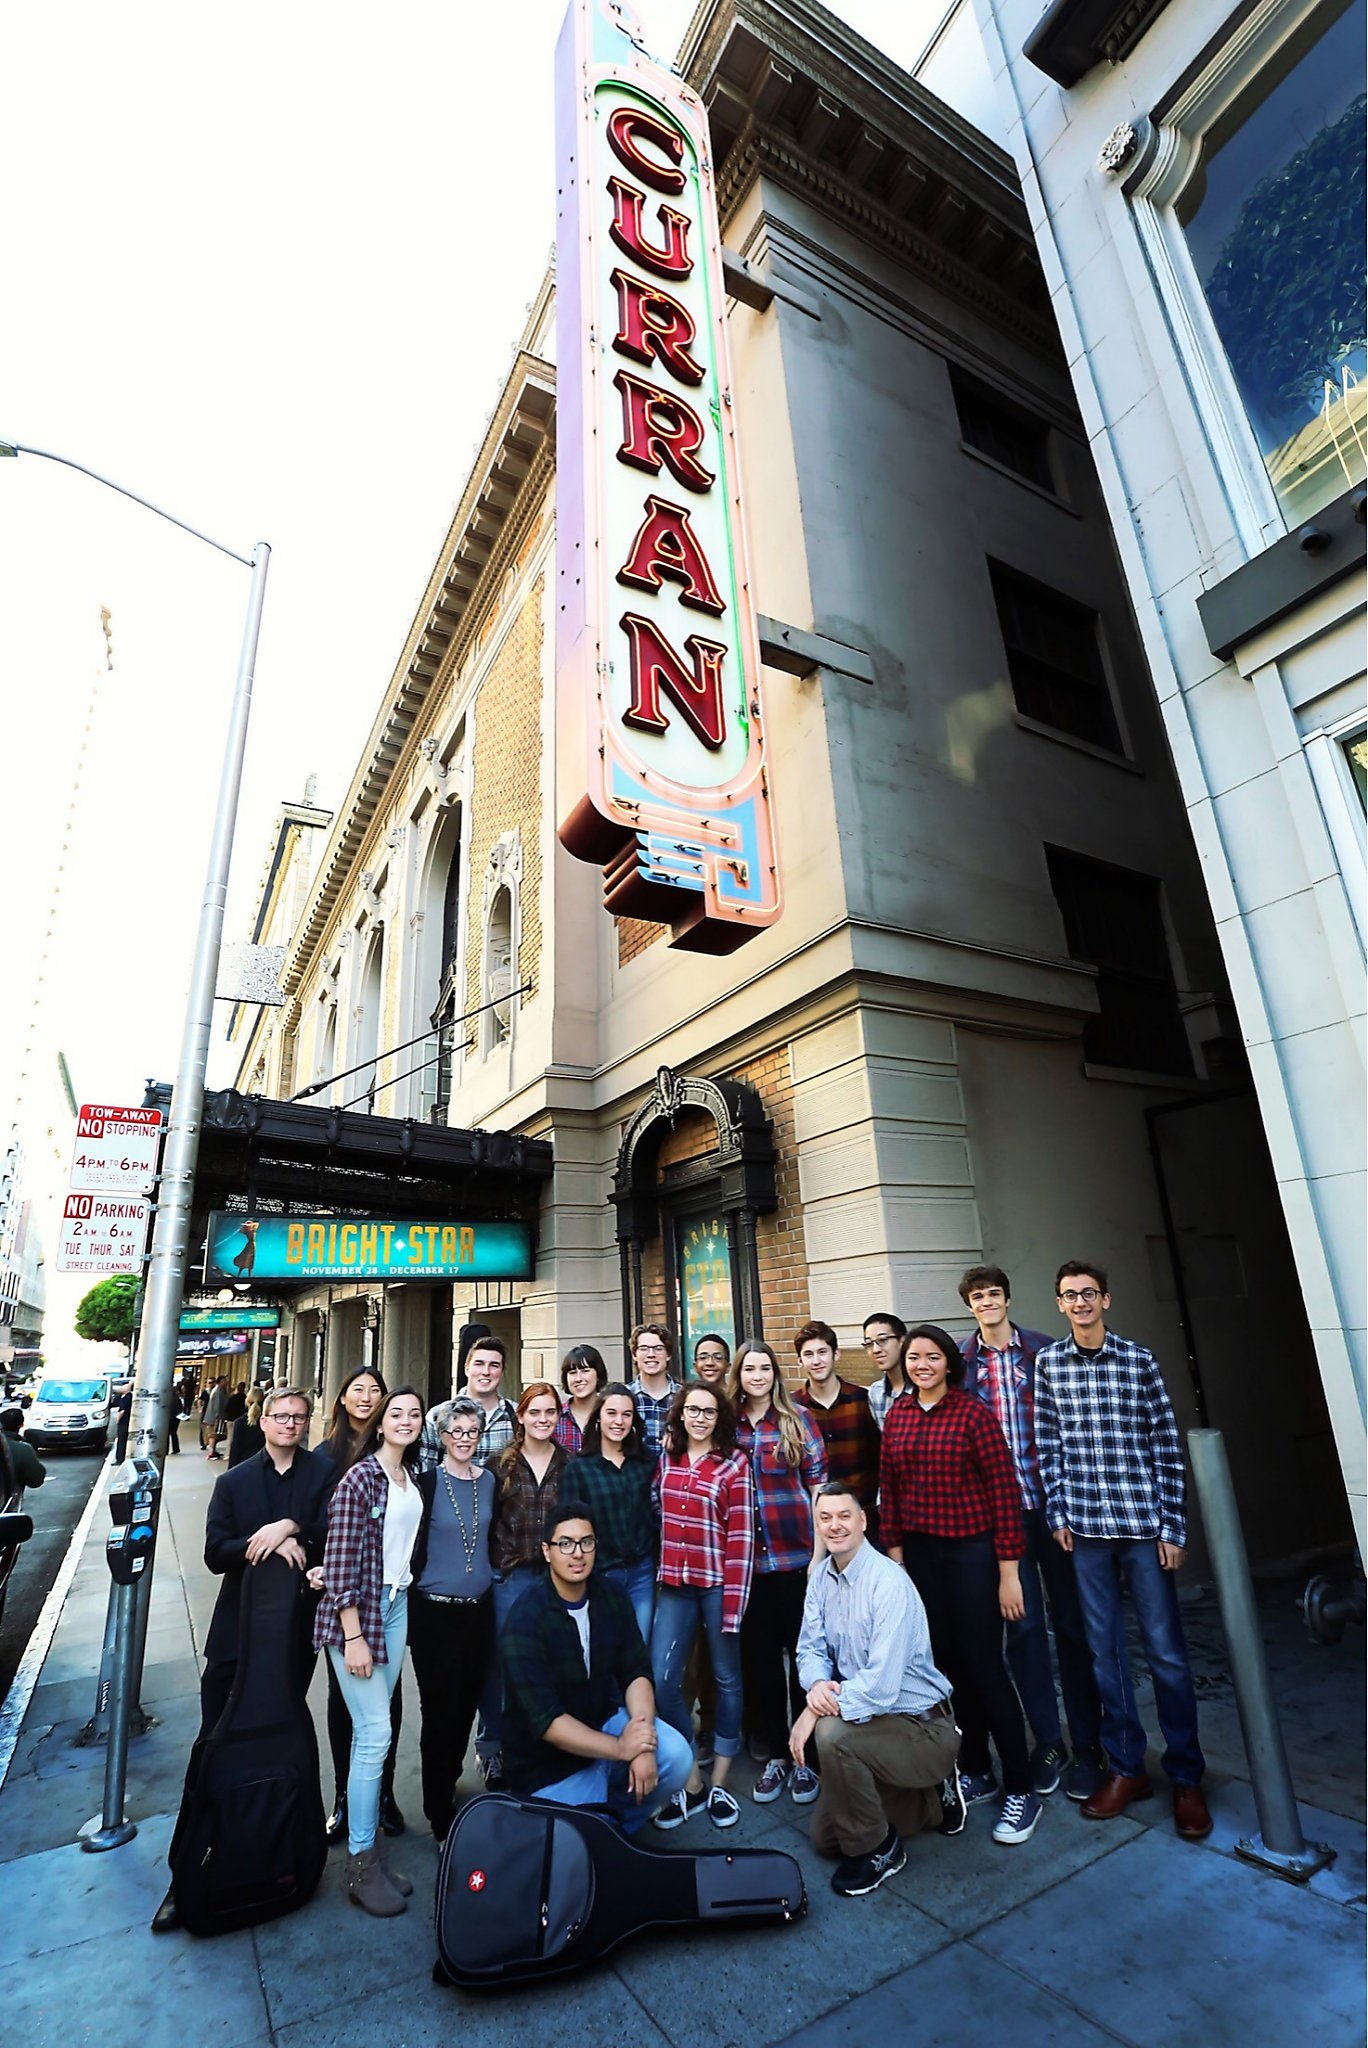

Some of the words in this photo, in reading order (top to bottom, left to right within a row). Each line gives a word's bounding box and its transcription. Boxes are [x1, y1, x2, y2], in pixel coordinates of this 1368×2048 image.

[606, 106, 727, 751] CURRAN
[89, 1107, 153, 1122] TOW-AWAY
[79, 1118, 103, 1136] NO
[106, 1123, 156, 1138] STOPPING
[66, 1196, 91, 1217] NO
[94, 1203, 144, 1219] PARKING
[286, 1223, 396, 1265] BRIGHT
[408, 1225, 475, 1264] STAR
[65, 1261, 93, 1270] STREET
[96, 1262, 132, 1271] CLEANING
[302, 1266, 363, 1275] NOVEMBER
[366, 1266, 378, 1275] 28
[389, 1266, 444, 1275] DECEMBER
[449, 1266, 459, 1275] 17
